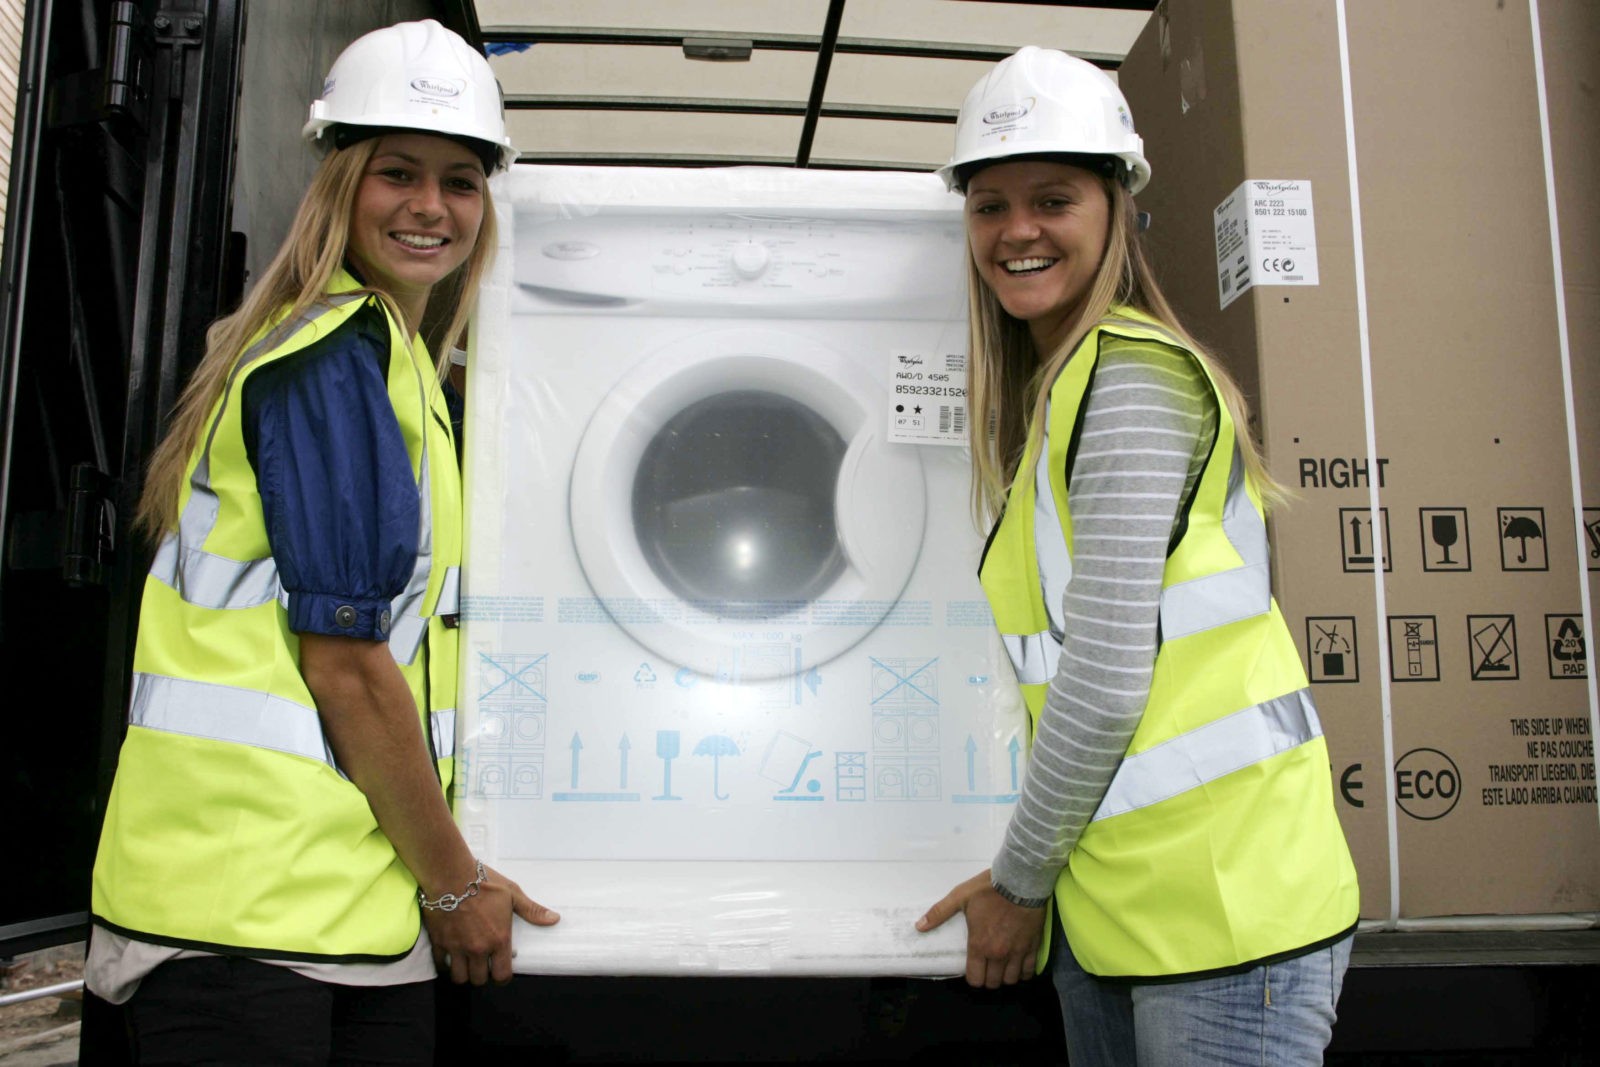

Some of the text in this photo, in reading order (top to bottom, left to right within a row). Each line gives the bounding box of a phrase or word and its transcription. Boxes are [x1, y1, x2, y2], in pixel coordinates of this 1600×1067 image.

[1257, 184, 1299, 192] Whirlpool
[928, 373, 949, 382] 4505
[1299, 458, 1389, 488] RIGHT
[1565, 639, 1576, 648] 20
[1562, 664, 1585, 674] PAP
[1510, 717, 1590, 736] THIS SIDE UP WHEN
[1527, 741, 1538, 758] NE
[1541, 741, 1557, 758] PAS
[1488, 763, 1596, 783] TRANSPORT LIEGEND, DIE
[1396, 769, 1456, 799] ECO
[1482, 788, 1504, 806] ESTE
[1506, 787, 1529, 805] LADO
[1531, 787, 1562, 804] ARRIBA
